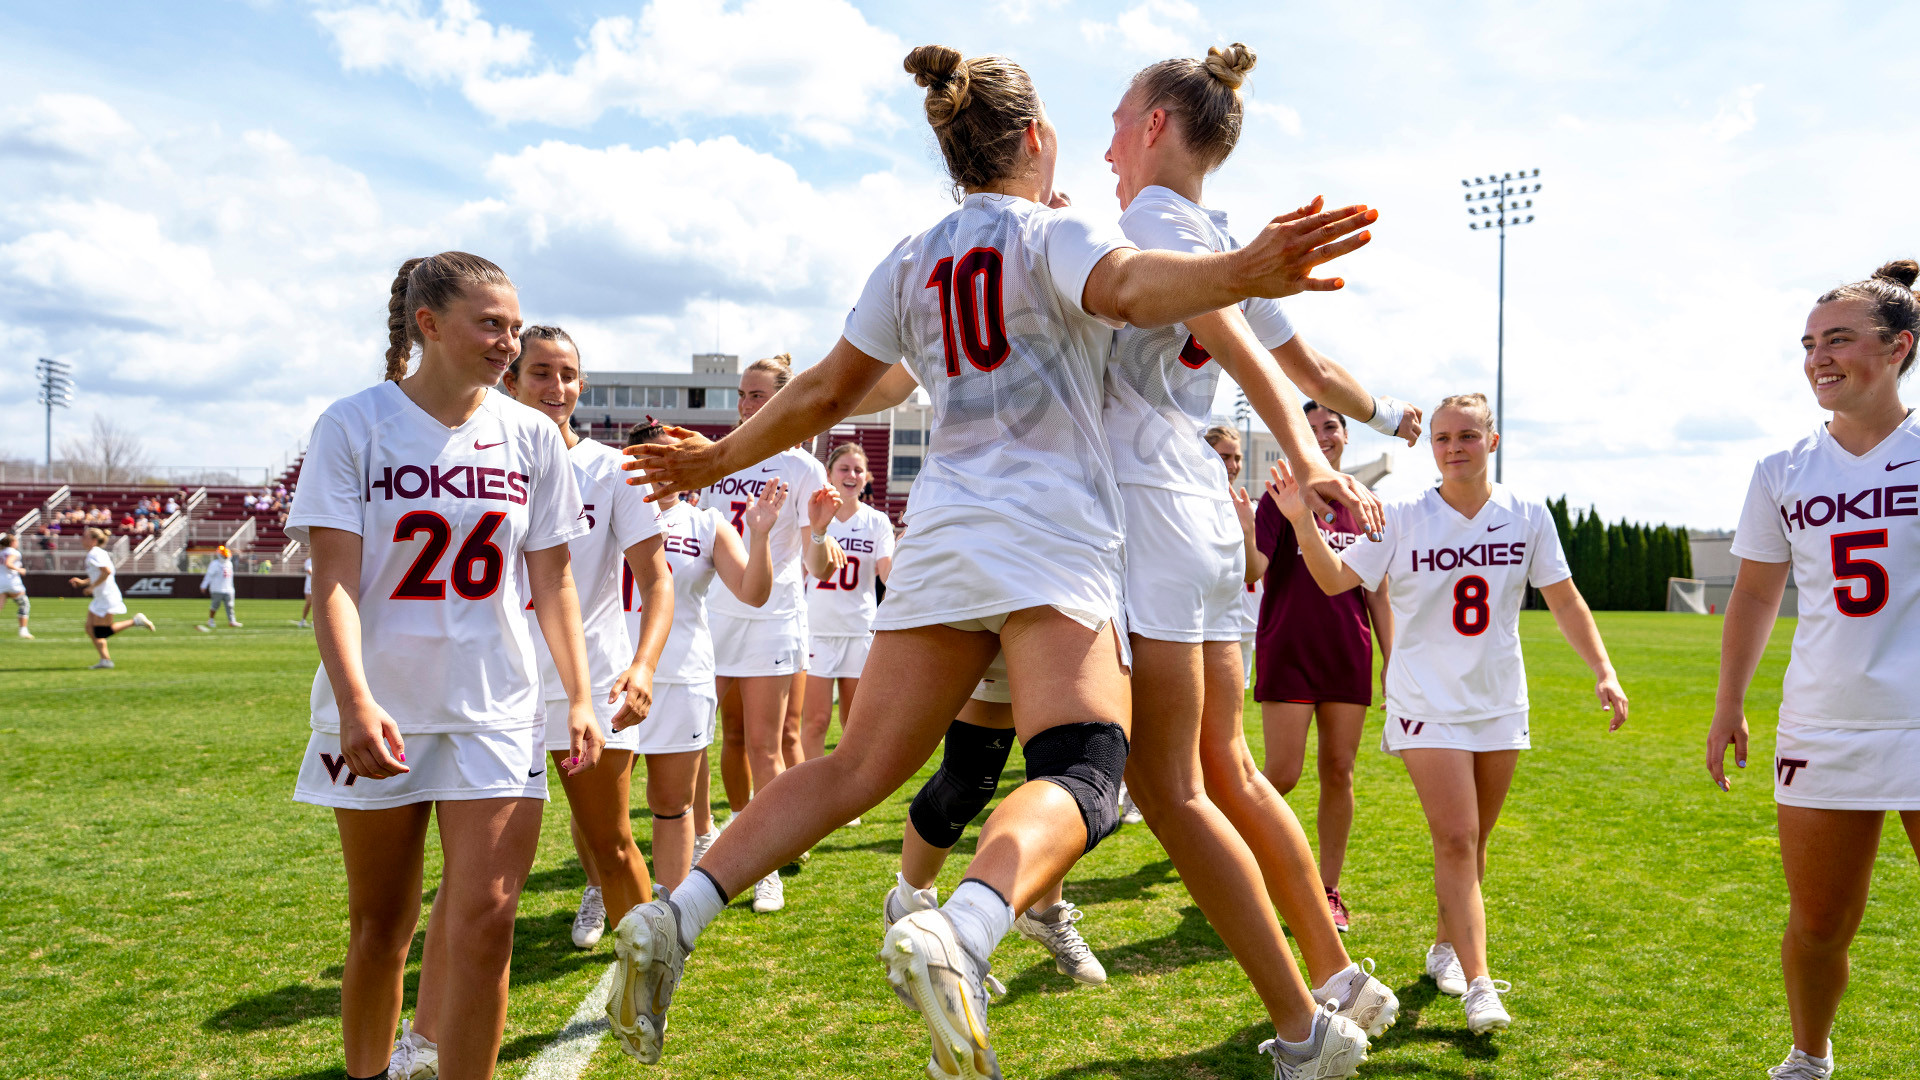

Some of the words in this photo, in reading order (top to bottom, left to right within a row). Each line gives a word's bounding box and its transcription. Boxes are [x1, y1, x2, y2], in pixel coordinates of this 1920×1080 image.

[925, 246, 1011, 377] 10
[367, 464, 530, 506] HOKIES
[710, 478, 788, 498] HOKIE
[1780, 484, 1919, 533] HOKIE
[389, 510, 508, 600] 26
[1411, 542, 1526, 572] HOKIES
[1830, 528, 1889, 617] 5
[126, 577, 175, 594] ACC
[1453, 574, 1490, 637] 8
